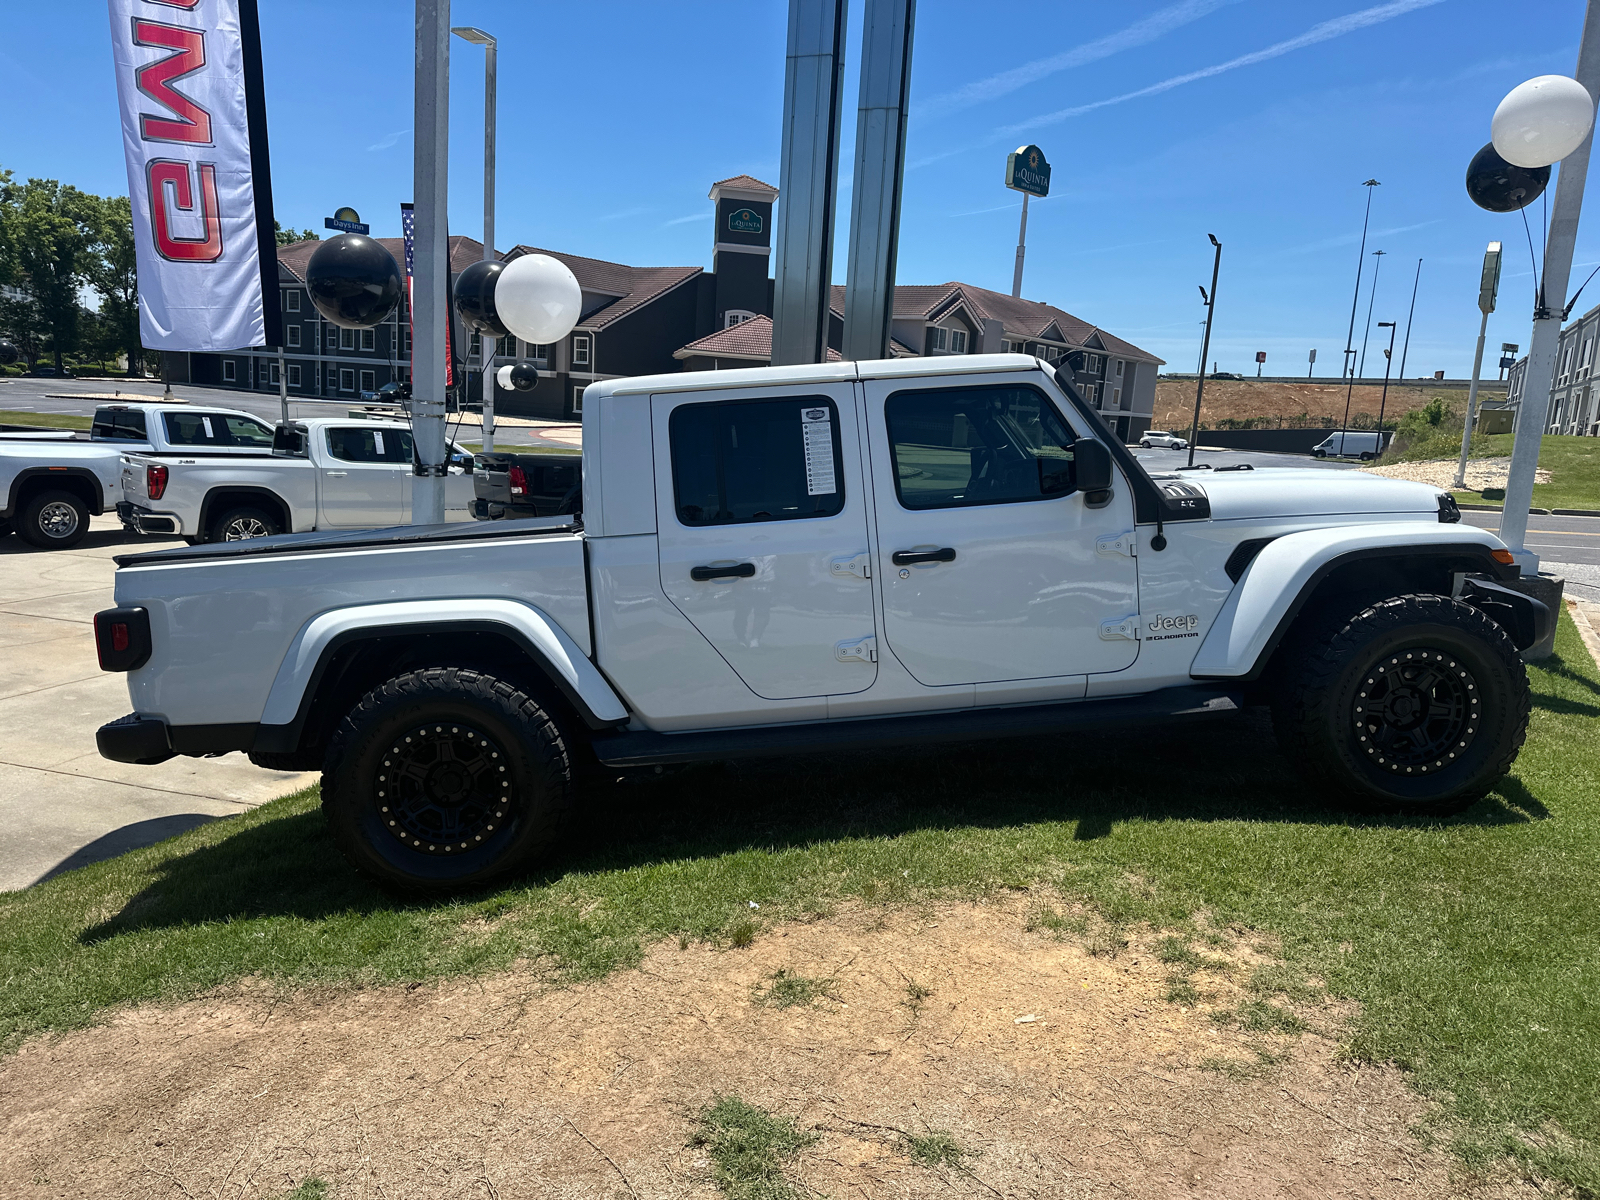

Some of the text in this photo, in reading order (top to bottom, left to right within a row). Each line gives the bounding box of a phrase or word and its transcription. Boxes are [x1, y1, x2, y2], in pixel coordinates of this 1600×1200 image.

[131, 0, 223, 262] GM
[1021, 168, 1048, 187] QUINTA
[333, 219, 351, 229] Days
[351, 222, 364, 231] Inn
[736, 220, 760, 228] QUINTA
[1149, 613, 1199, 632] Jeep
[1153, 632, 1199, 641] GLADIATOR
